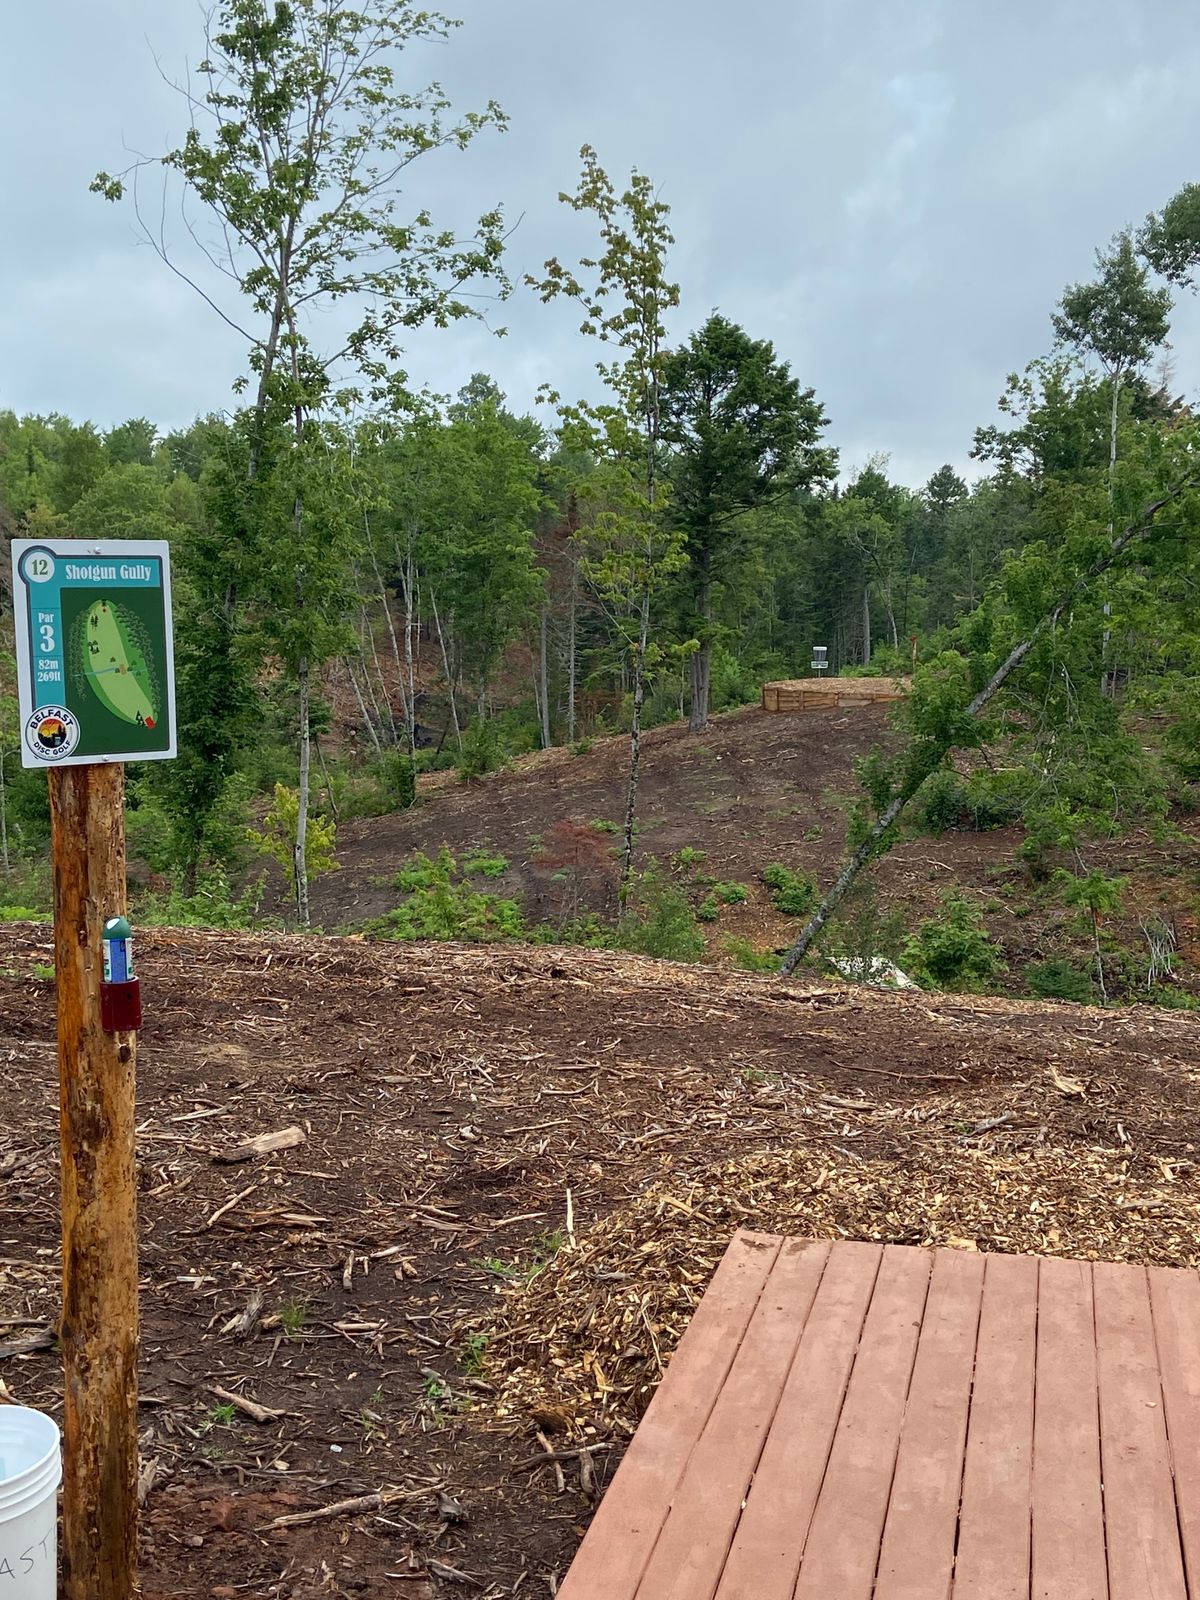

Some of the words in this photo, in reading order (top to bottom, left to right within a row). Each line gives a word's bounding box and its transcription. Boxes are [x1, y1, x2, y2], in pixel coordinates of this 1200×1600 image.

[31, 559, 49, 576] 12
[65, 565, 116, 582] Shotgun
[120, 564, 152, 581] Gully
[38, 612, 54, 623] Par
[39, 625, 55, 652] 3
[38, 659, 59, 670] 82m
[37, 671, 61, 682] 269ft
[30, 709, 74, 730] BELFAST
[33, 741, 51, 755] DISC
[52, 739, 71, 755] GOLF
